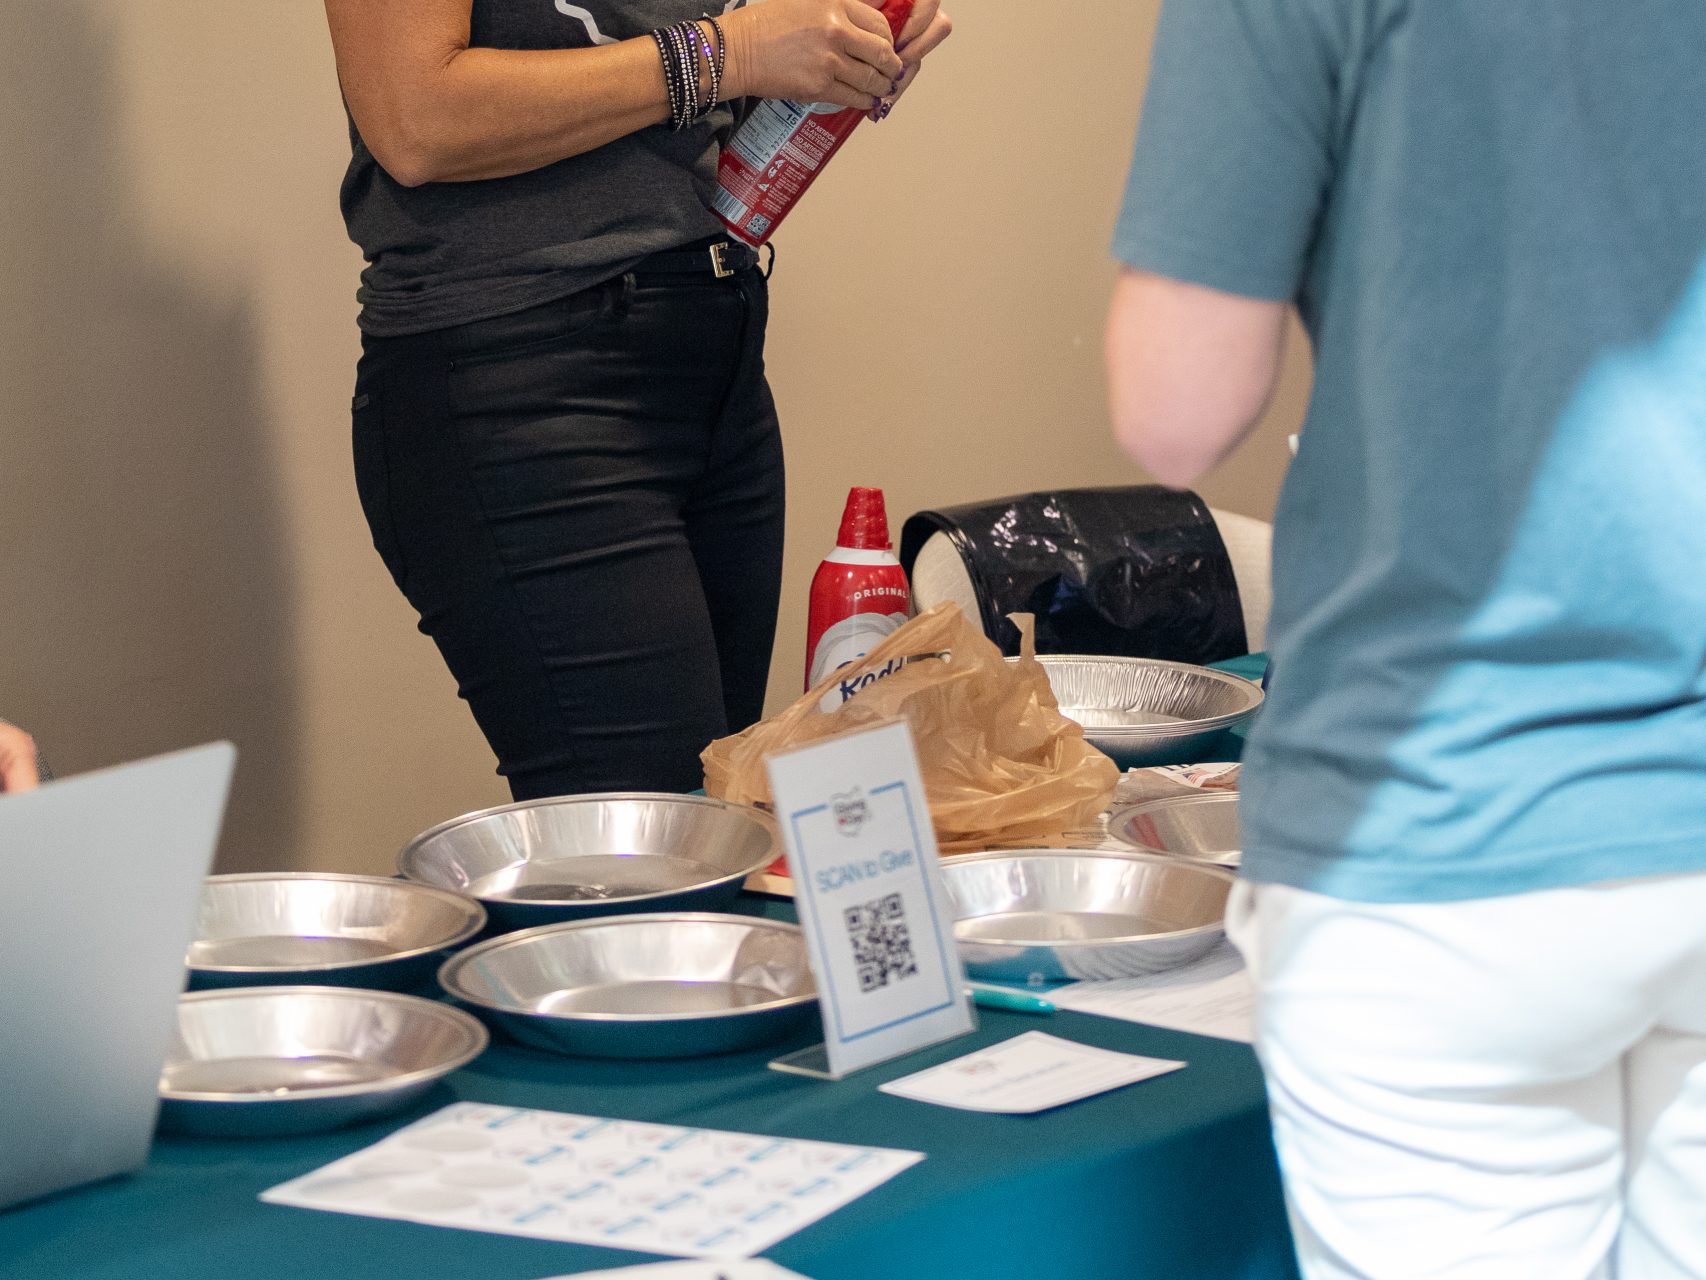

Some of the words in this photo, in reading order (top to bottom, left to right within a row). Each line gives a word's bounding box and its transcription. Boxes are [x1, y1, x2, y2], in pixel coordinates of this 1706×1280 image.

[784, 112, 798, 126] 15
[806, 119, 816, 128] NO
[794, 134, 803, 143] NO
[803, 123, 828, 144] FLAVORS
[853, 587, 907, 600] ORIGINAL
[816, 864, 863, 892] SCAN
[880, 850, 912, 872] Give
